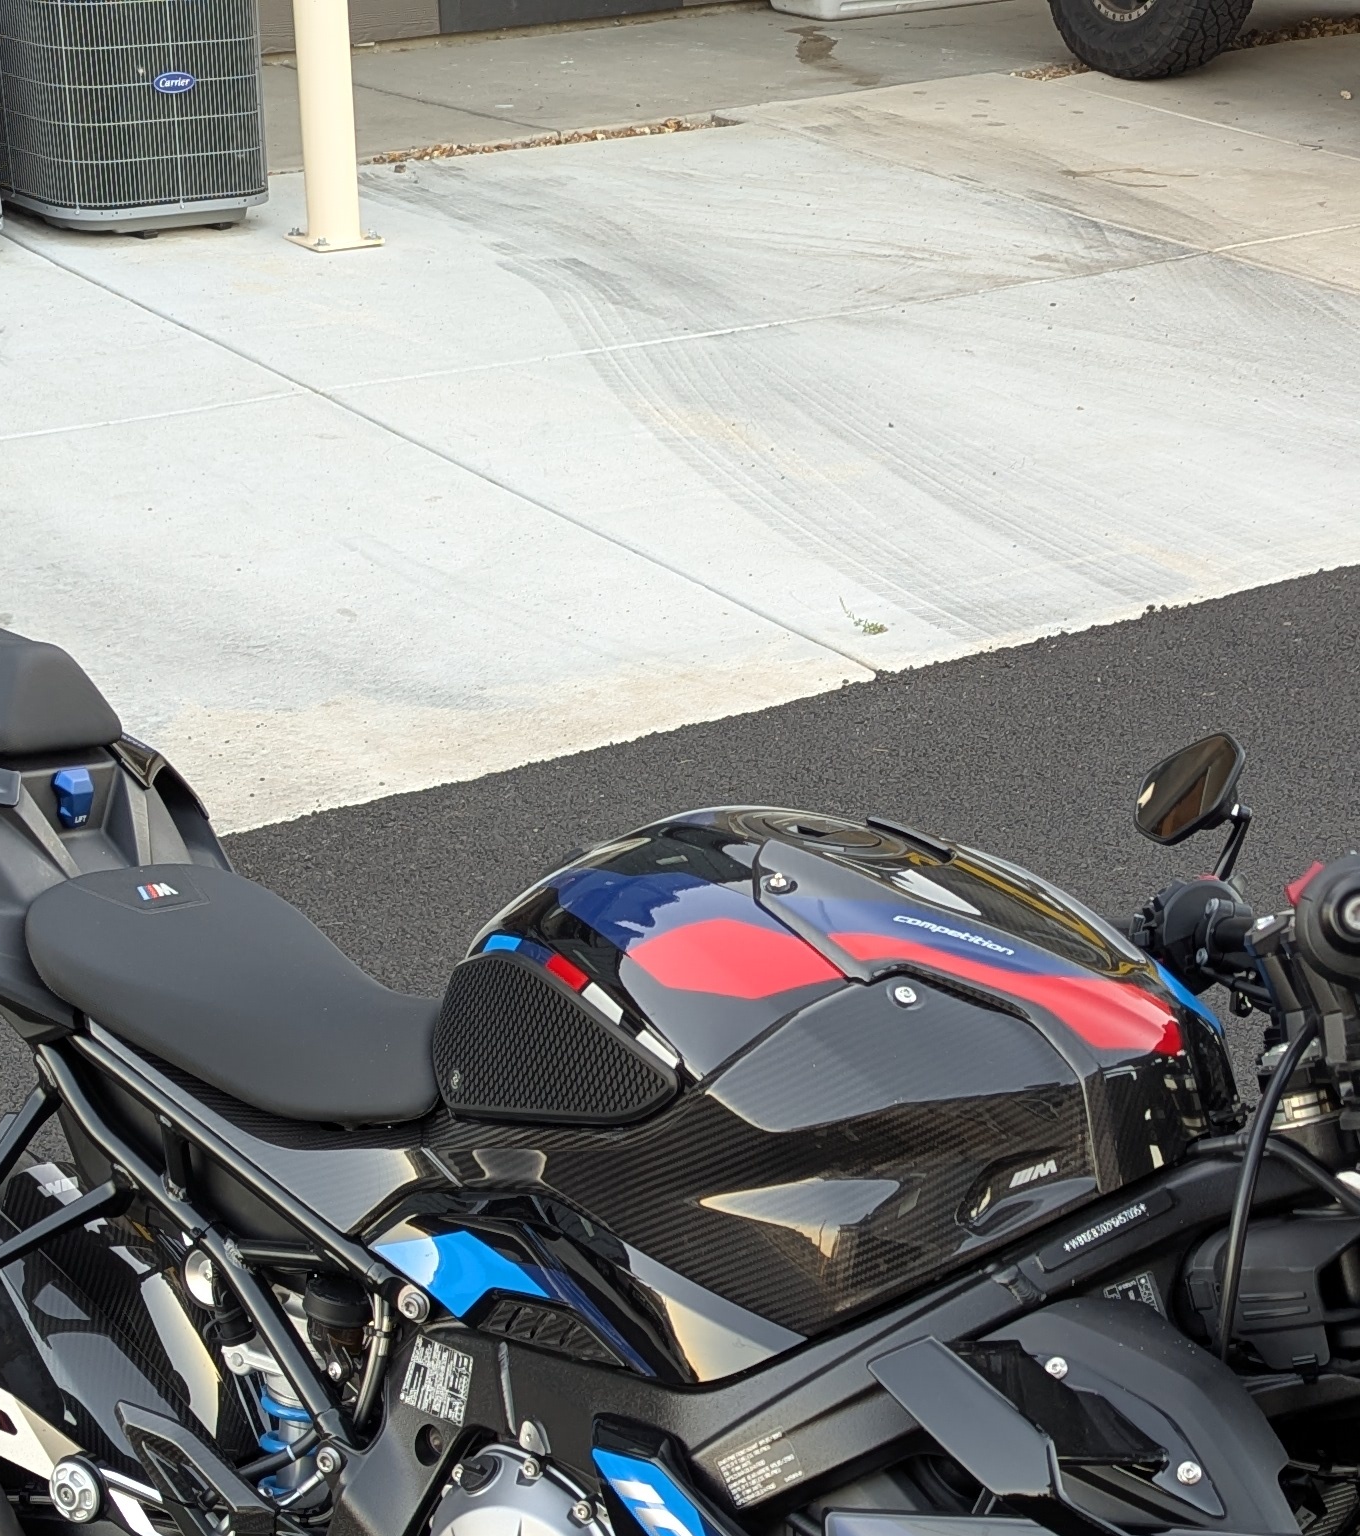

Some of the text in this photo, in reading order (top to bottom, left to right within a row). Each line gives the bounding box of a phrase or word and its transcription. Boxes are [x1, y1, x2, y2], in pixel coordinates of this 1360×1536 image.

[158, 76, 191, 89] Carrier
[74, 814, 87, 824] LIFT
[893, 915, 1015, 956] competition
